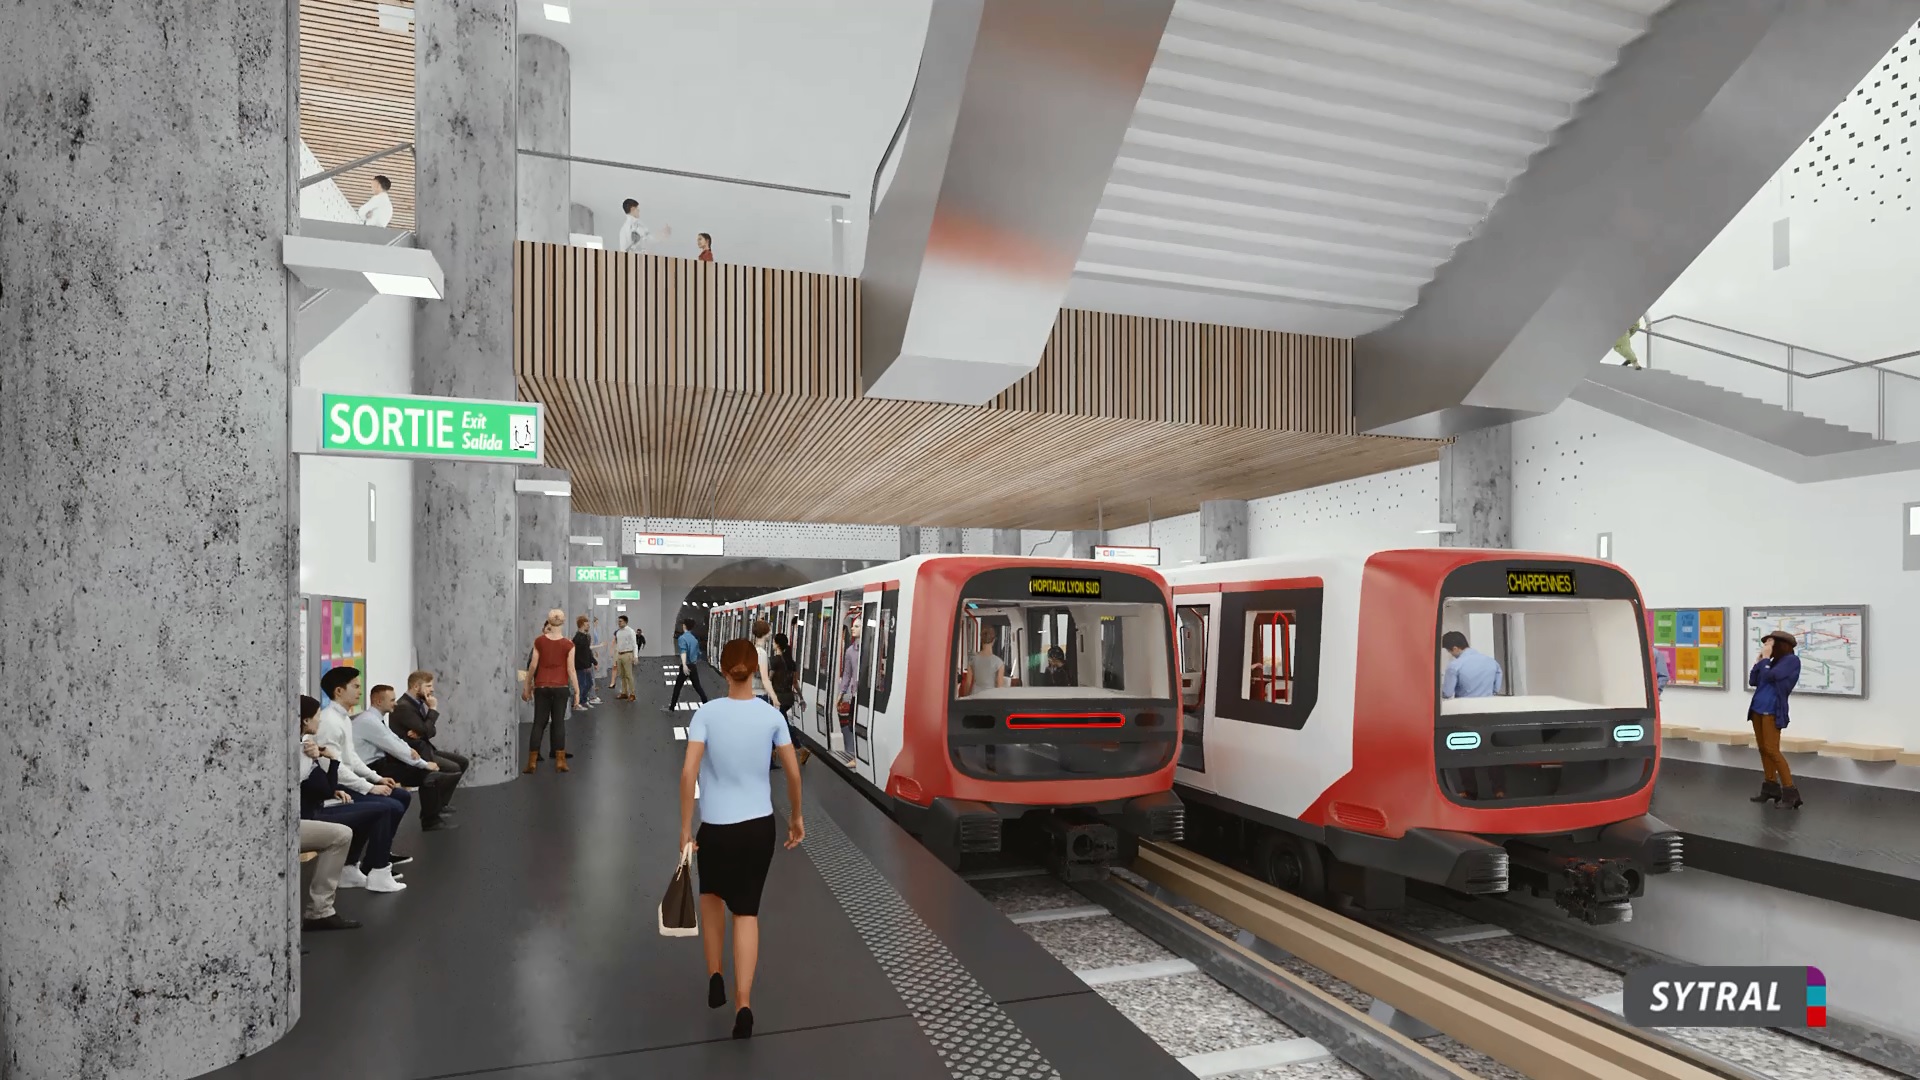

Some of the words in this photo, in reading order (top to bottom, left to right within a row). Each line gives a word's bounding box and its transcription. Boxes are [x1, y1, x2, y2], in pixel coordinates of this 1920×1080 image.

[330, 402, 454, 449] SORTIE
[461, 410, 487, 430] Exit
[461, 432, 503, 451] Salida
[577, 568, 607, 581] SORTIE
[1508, 573, 1572, 592] CHARPENNES
[1032, 579, 1066, 593] HOPITAUX
[1067, 580, 1085, 594] LYON
[1085, 581, 1100, 595] SUD
